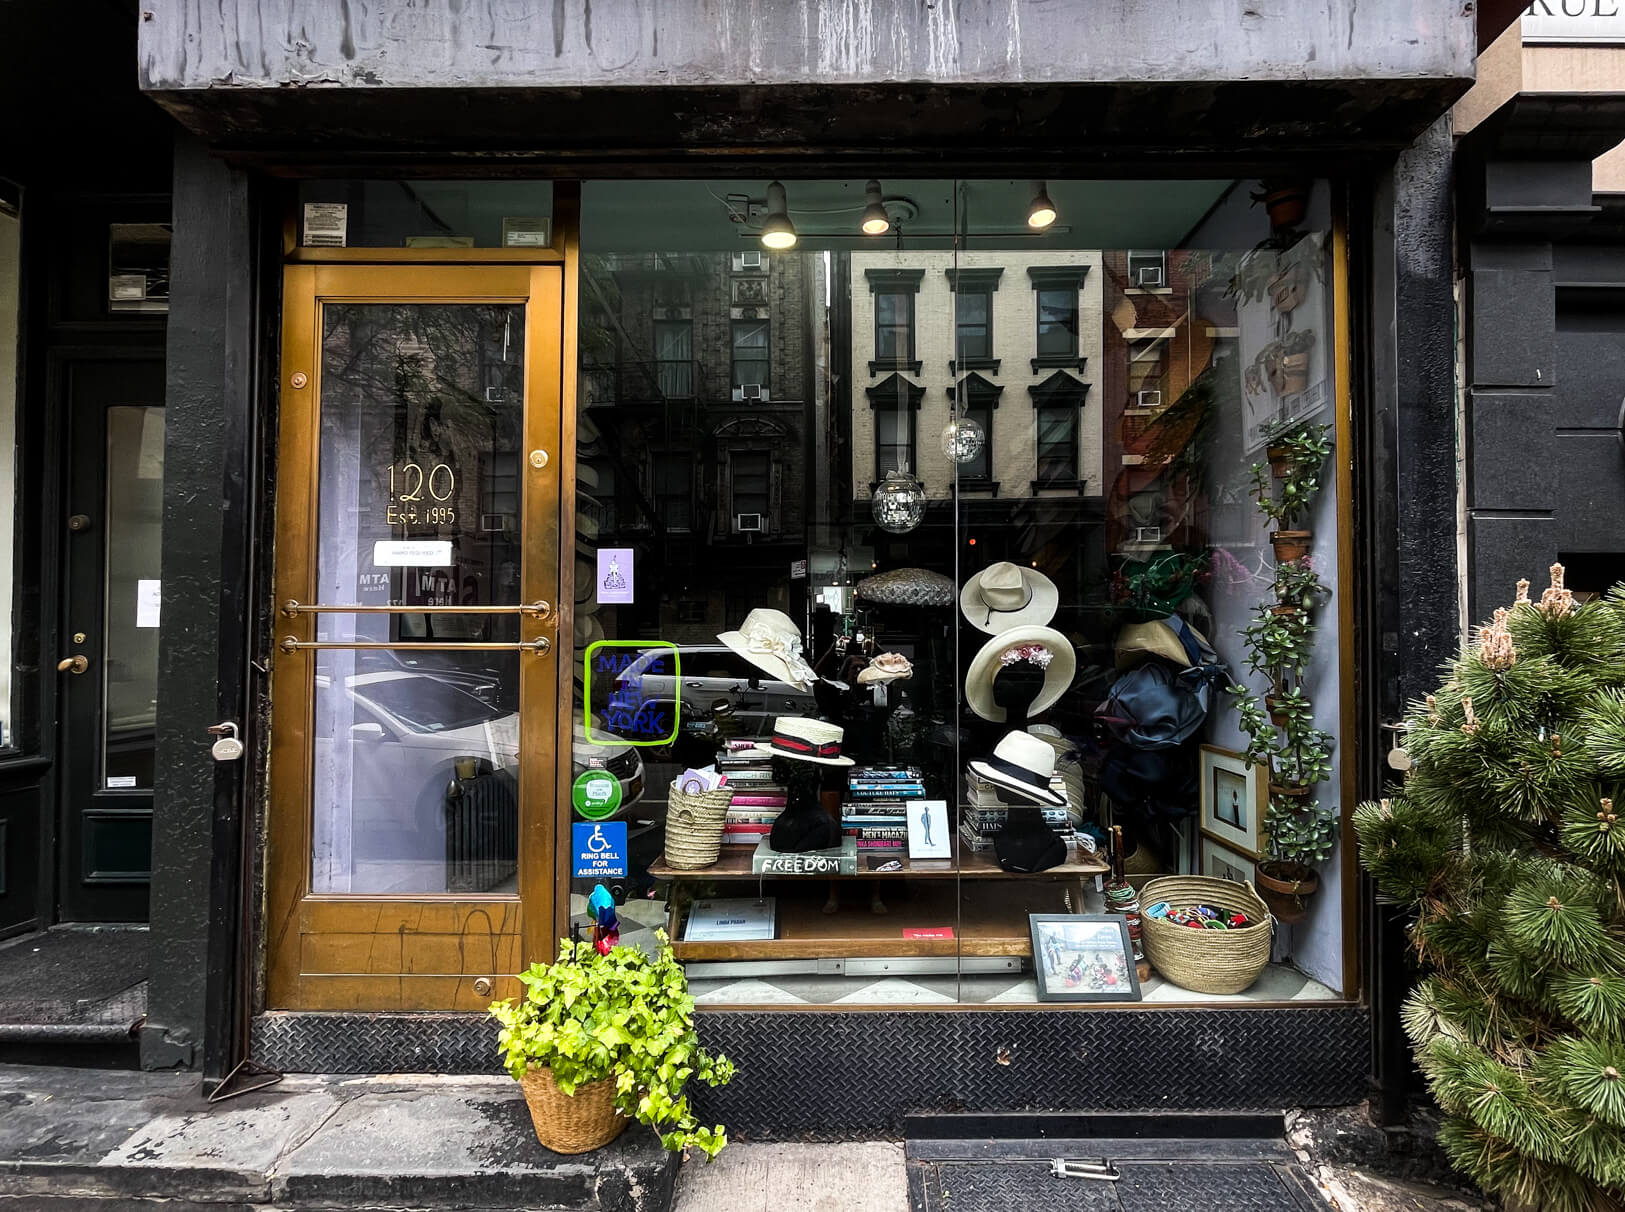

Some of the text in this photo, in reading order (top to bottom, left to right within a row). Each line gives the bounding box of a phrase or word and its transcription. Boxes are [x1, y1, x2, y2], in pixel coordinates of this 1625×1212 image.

[387, 463, 455, 501] 120
[386, 505, 455, 525] Est. 1995
[596, 653, 665, 673] MADE
[601, 708, 665, 734] YORK
[581, 852, 620, 860] RING BELL
[761, 857, 841, 873] FREEDOM
[577, 867, 623, 875] ASSISTANCE
